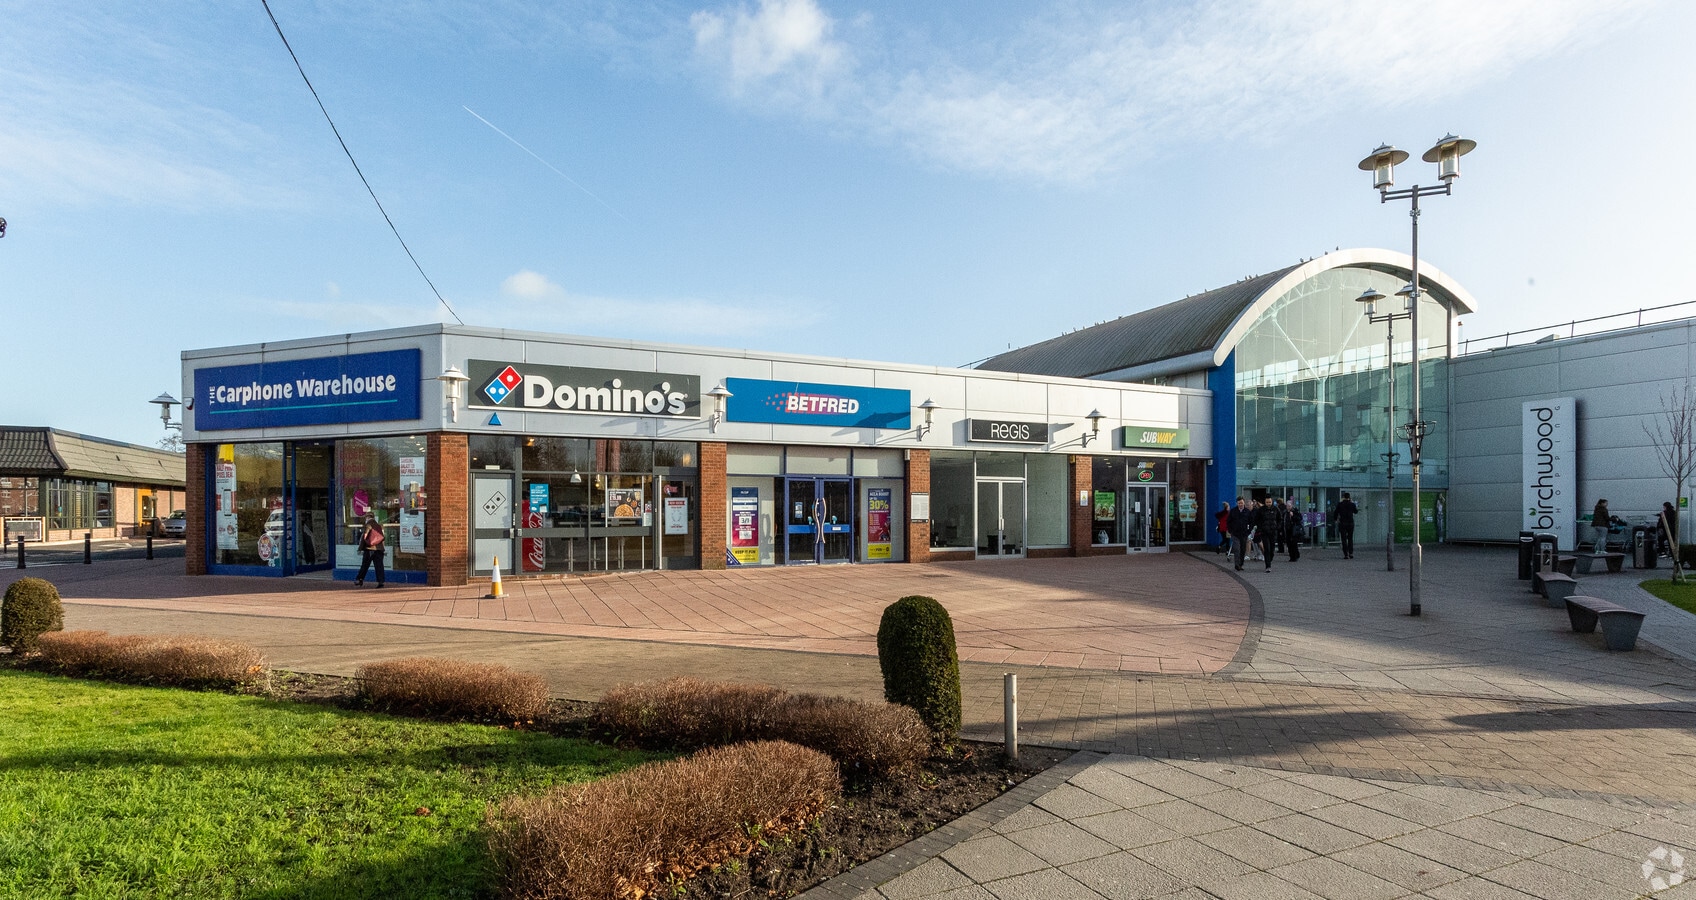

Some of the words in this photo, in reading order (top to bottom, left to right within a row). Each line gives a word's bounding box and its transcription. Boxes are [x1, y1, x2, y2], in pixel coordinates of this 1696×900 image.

[216, 381, 293, 406] Carphone
[296, 374, 396, 397] Warehouse
[523, 374, 687, 415] Domino's
[787, 395, 859, 414] BETFRED
[1140, 431, 1176, 444] SUBWAY
[1137, 461, 1155, 469] SUBWAY
[1530, 407, 1553, 530] birchwood
[869, 499, 889, 510] 30%
